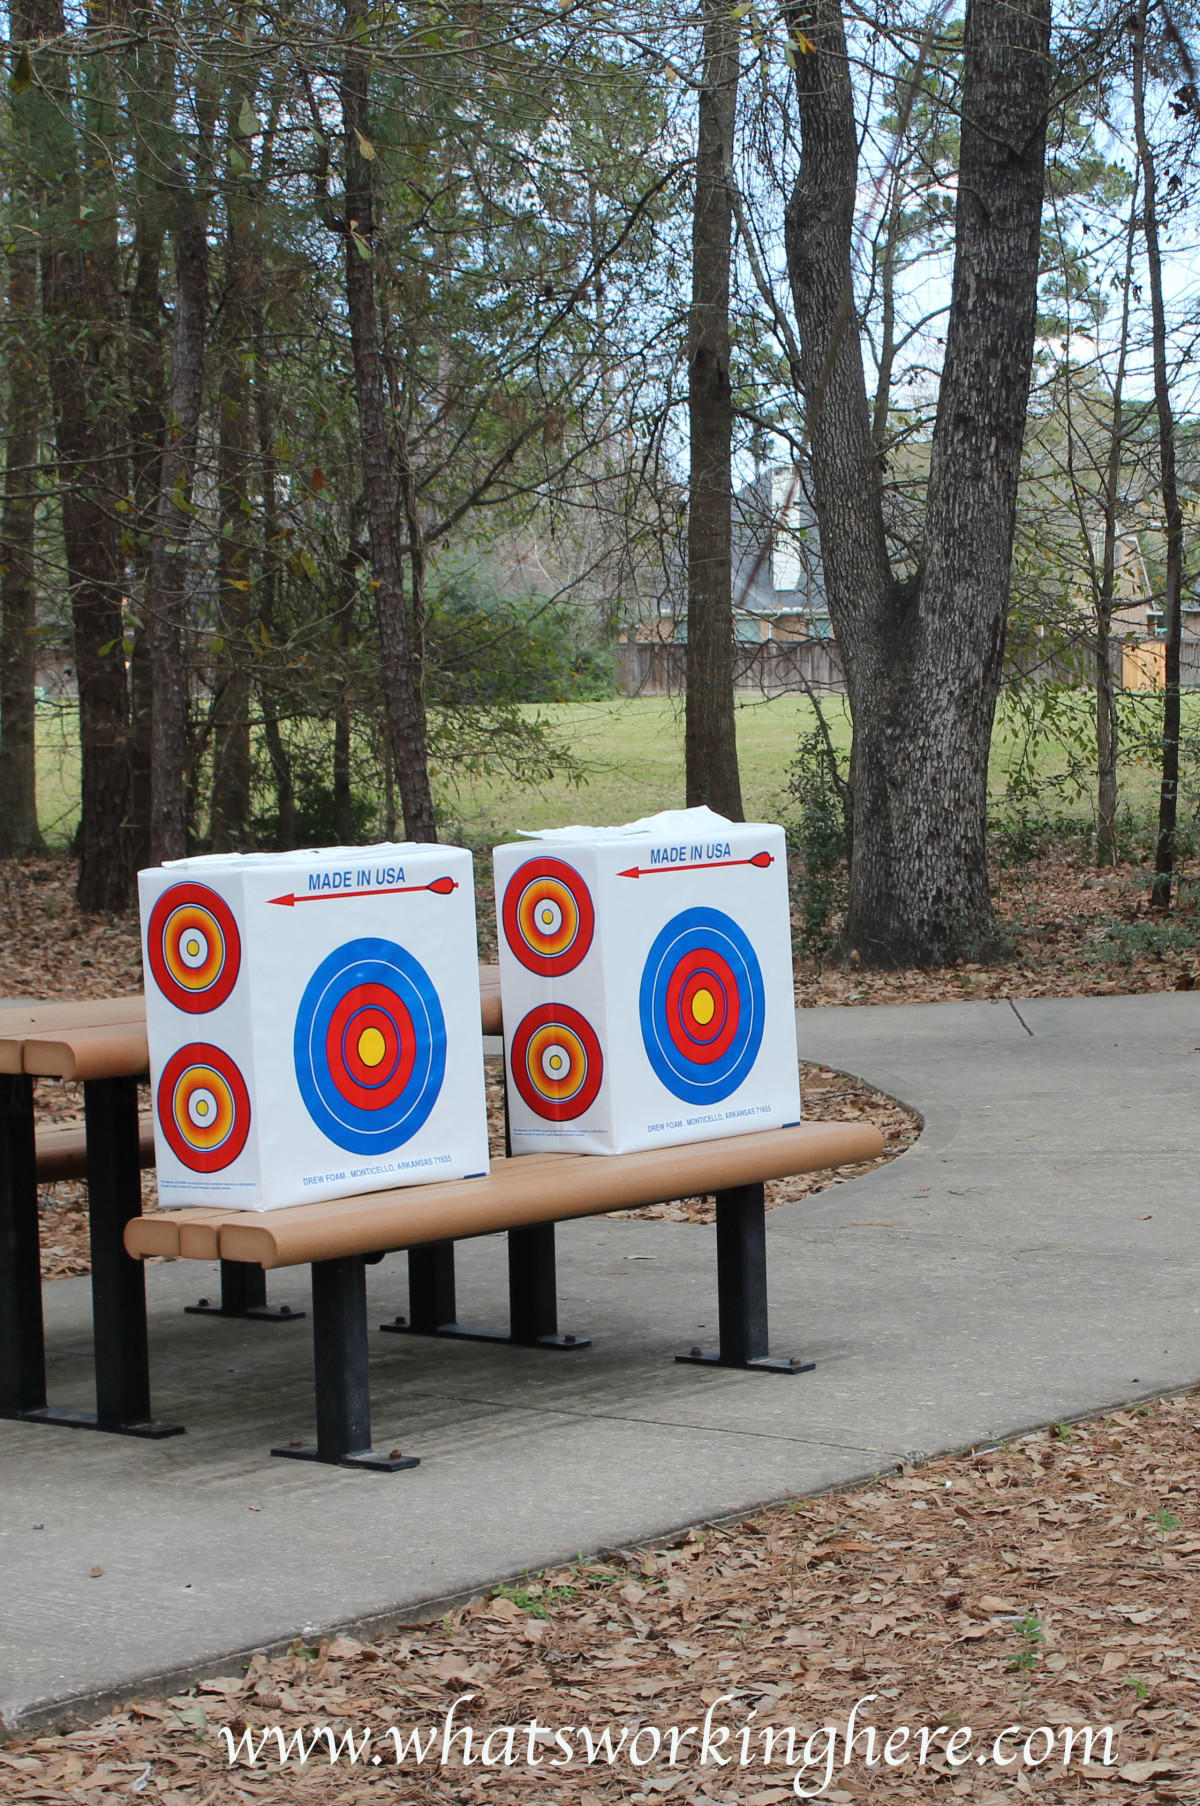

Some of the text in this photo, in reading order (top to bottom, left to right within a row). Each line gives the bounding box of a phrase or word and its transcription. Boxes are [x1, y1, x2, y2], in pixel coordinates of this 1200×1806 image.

[650, 842, 731, 864] MADE IN USA
[308, 867, 406, 891] MADE IN USA
[647, 1122, 665, 1133] DREW
[666, 1120, 683, 1129] FOAM
[686, 1113, 725, 1126] MONTICELLO,
[725, 1107, 756, 1120] ARKANSAS
[302, 1174, 324, 1186] DREW
[325, 1171, 346, 1183] FOAM
[350, 1164, 397, 1178] MONTICELLO,
[397, 1157, 434, 1170] ARKANSAS
